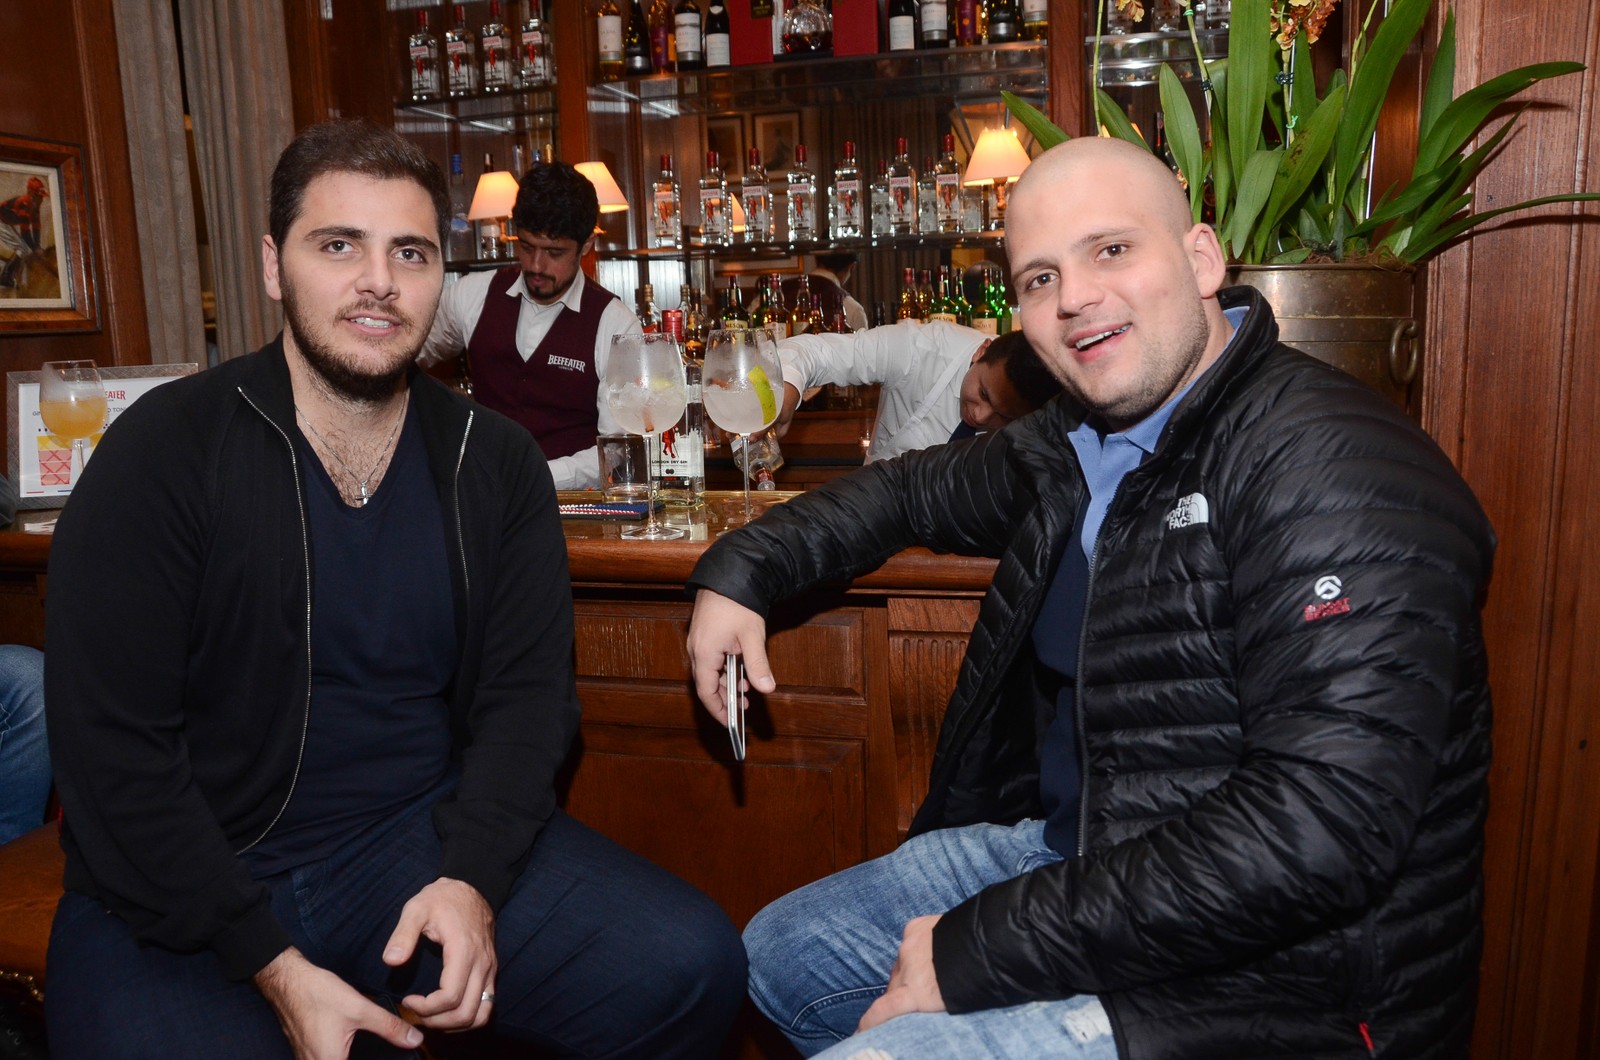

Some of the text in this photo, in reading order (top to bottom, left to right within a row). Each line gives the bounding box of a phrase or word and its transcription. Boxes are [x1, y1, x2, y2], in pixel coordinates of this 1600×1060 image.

[547, 354, 586, 373] BEEFEATER
[105, 390, 126, 400] EATER
[1169, 514, 1192, 530] FACE
